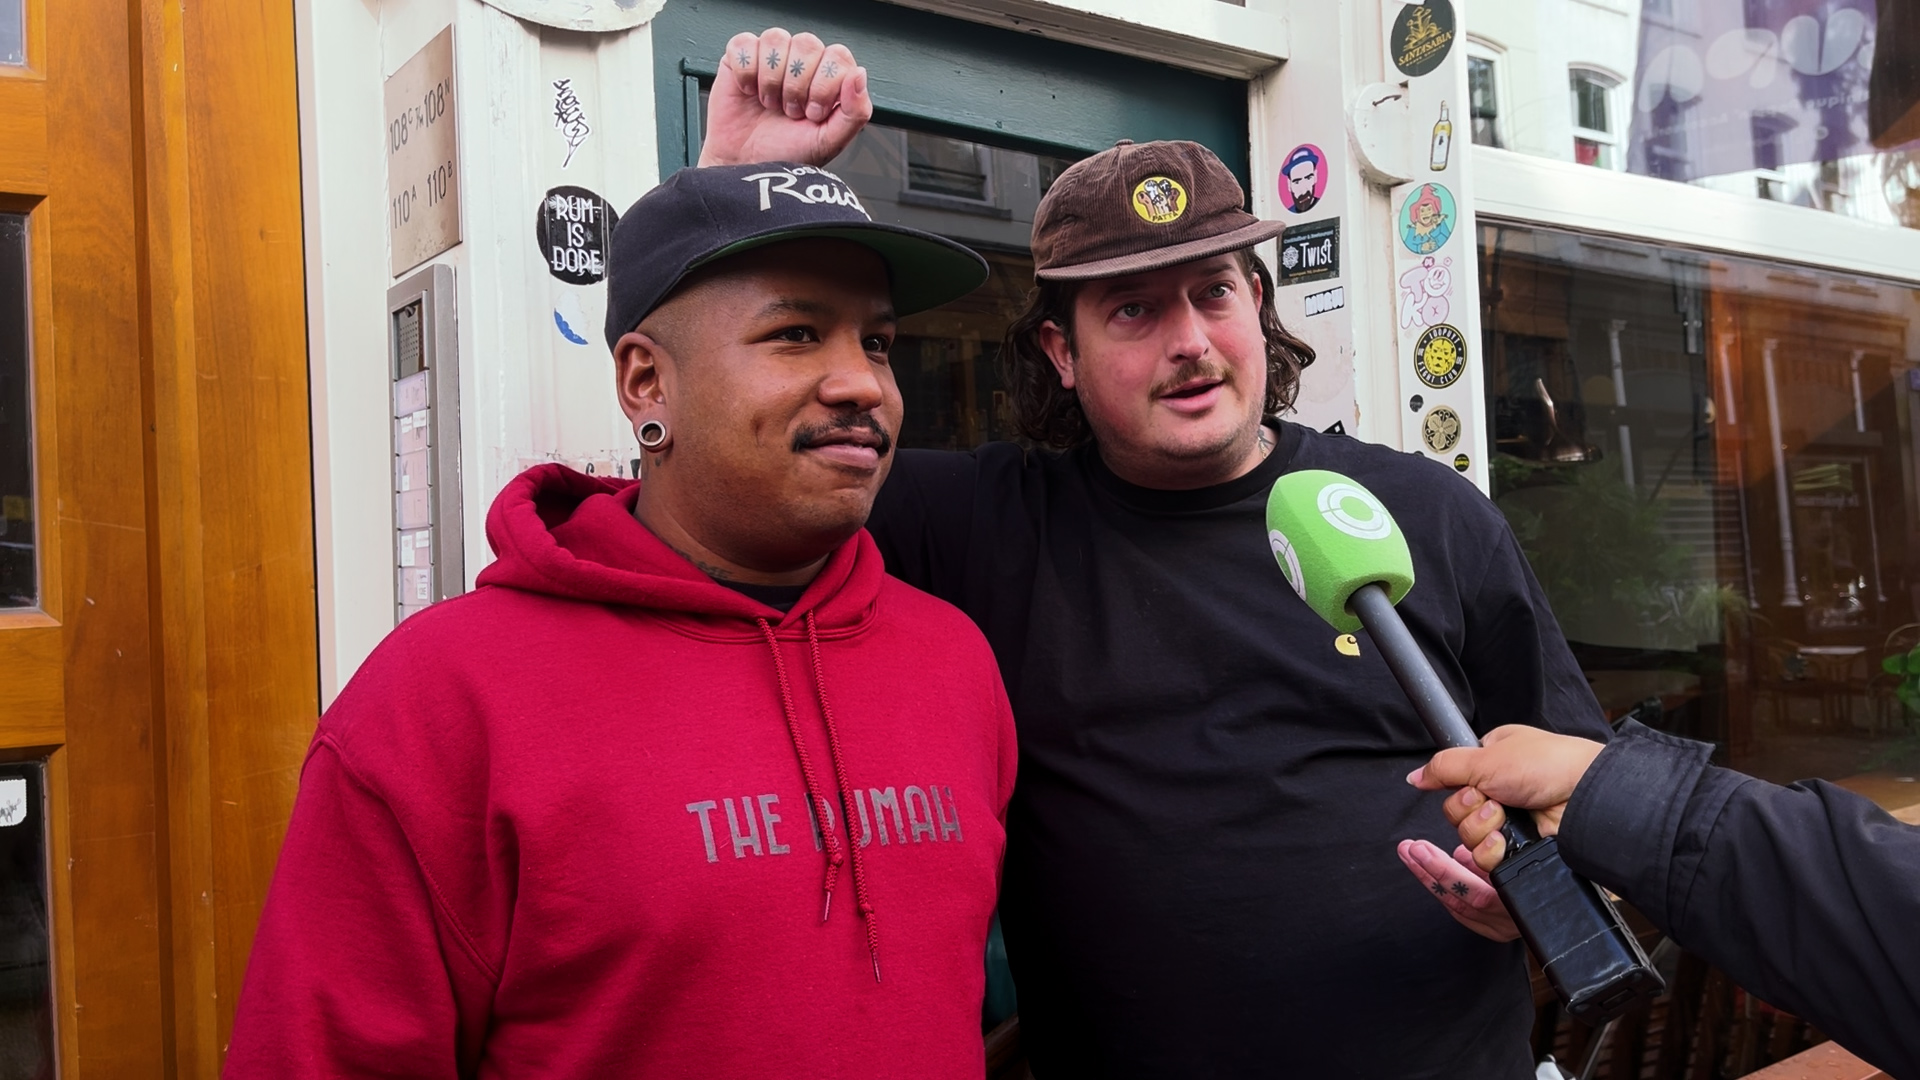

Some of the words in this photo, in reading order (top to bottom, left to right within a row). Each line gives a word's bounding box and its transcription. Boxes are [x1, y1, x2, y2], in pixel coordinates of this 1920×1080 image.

[555, 194, 594, 224] RUM
[741, 171, 872, 222] Raid
[566, 222, 585, 248] IS
[552, 245, 602, 276] DOPE
[1299, 238, 1332, 268] Twist
[1418, 361, 1435, 383] FIGHT
[1440, 369, 1458, 384] CLUB
[686, 793, 790, 863] THE
